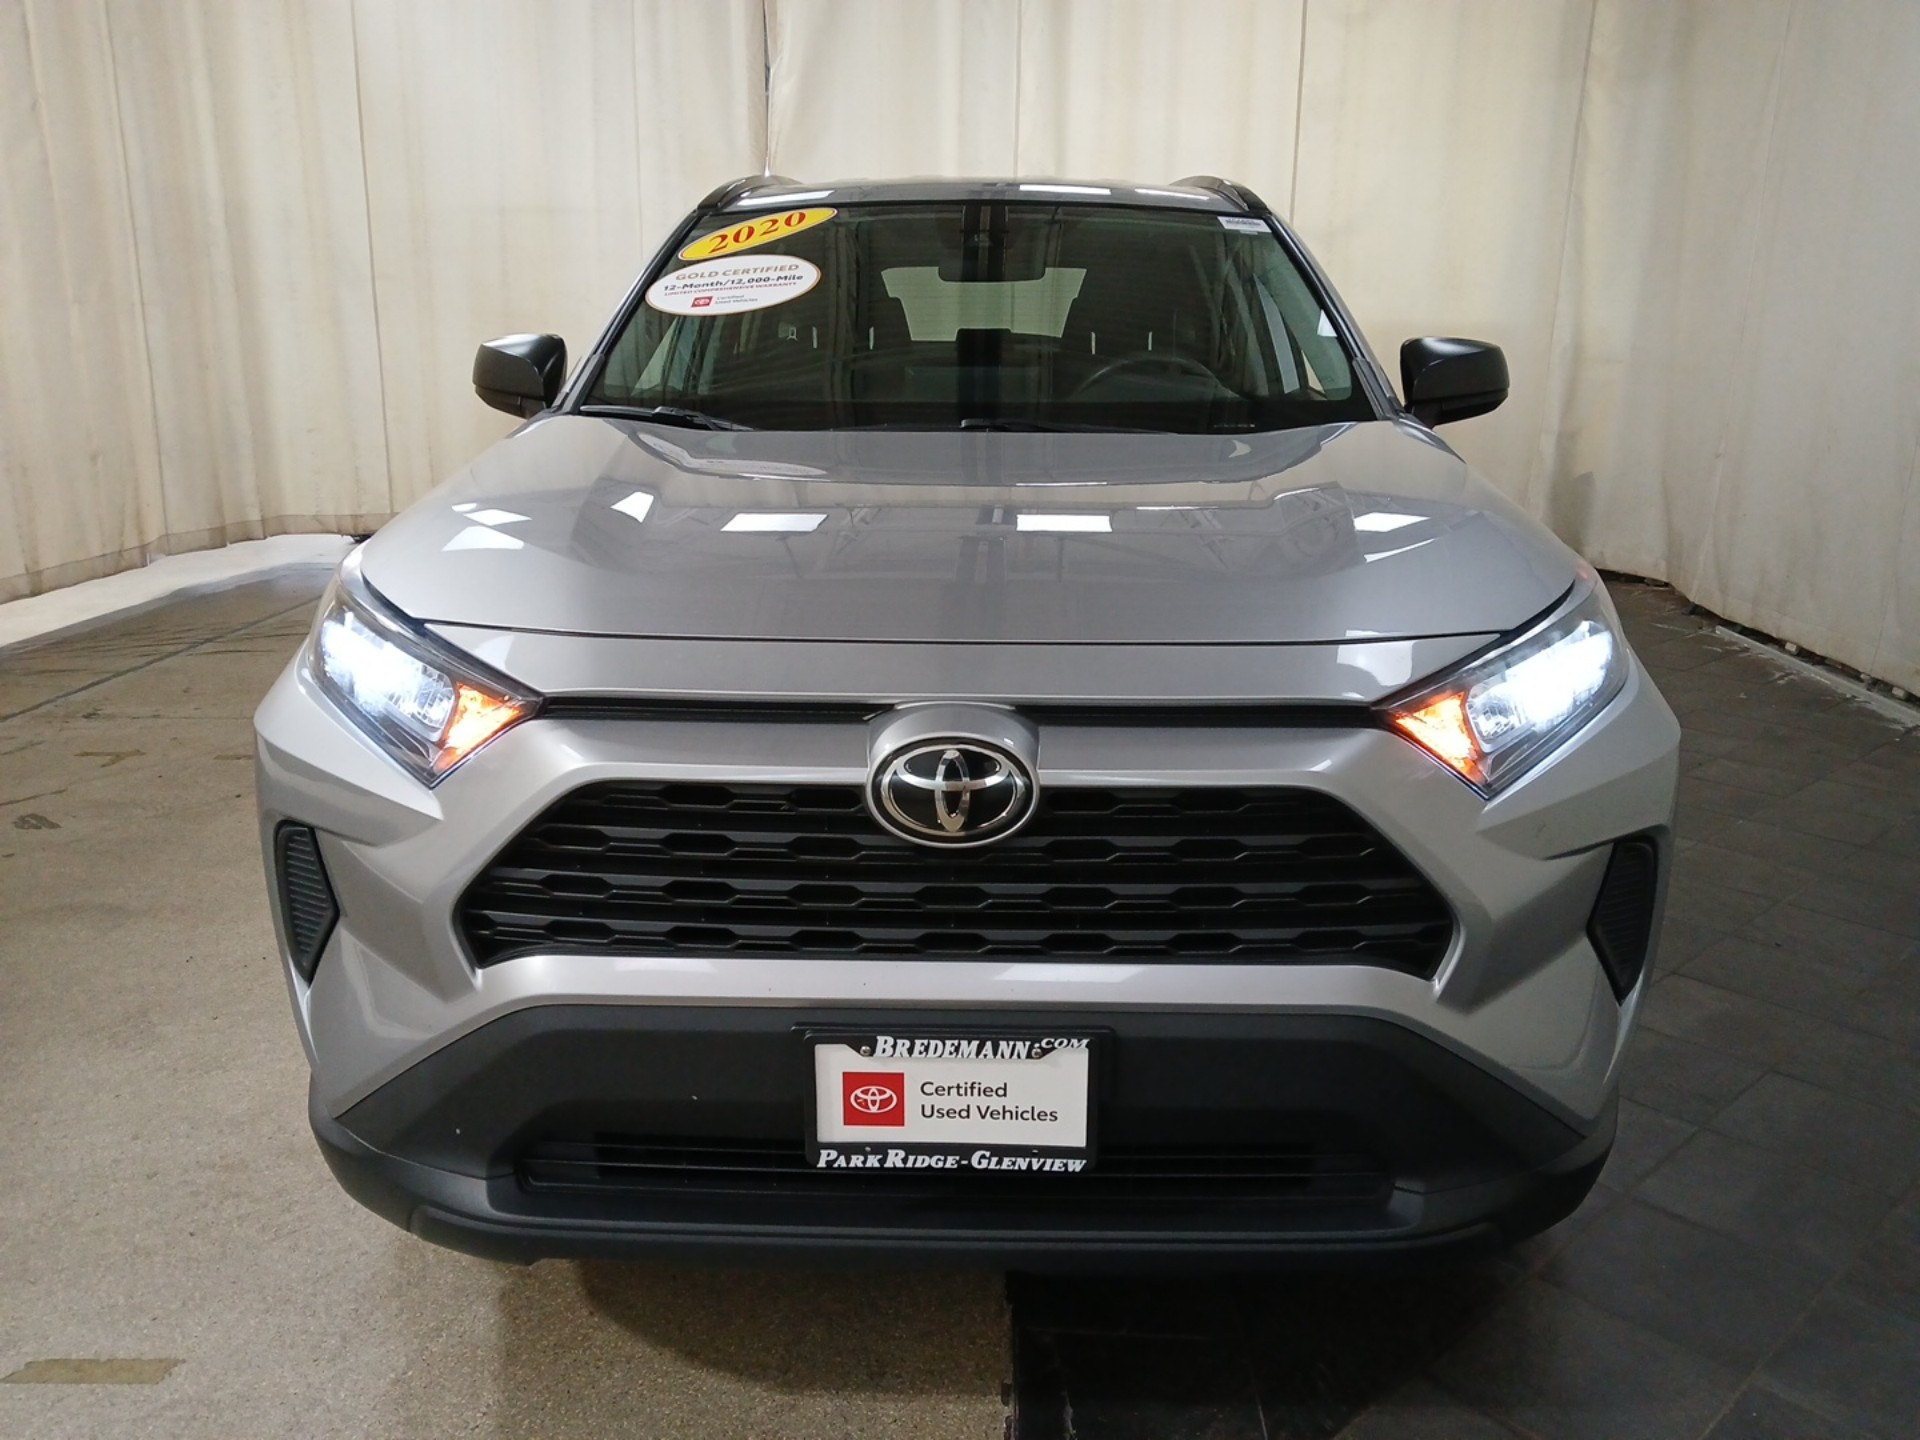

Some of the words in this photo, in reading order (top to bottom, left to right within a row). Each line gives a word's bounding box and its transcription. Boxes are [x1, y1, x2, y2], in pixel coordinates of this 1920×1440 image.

[708, 211, 807, 254] 2020
[676, 271, 719, 281] GOLD
[722, 264, 799, 277] CERTIFIED
[920, 1081, 1008, 1098] Certified
[921, 1104, 970, 1119] Used
[976, 1105, 1058, 1122] Vehicles
[817, 1149, 882, 1168] PARK
